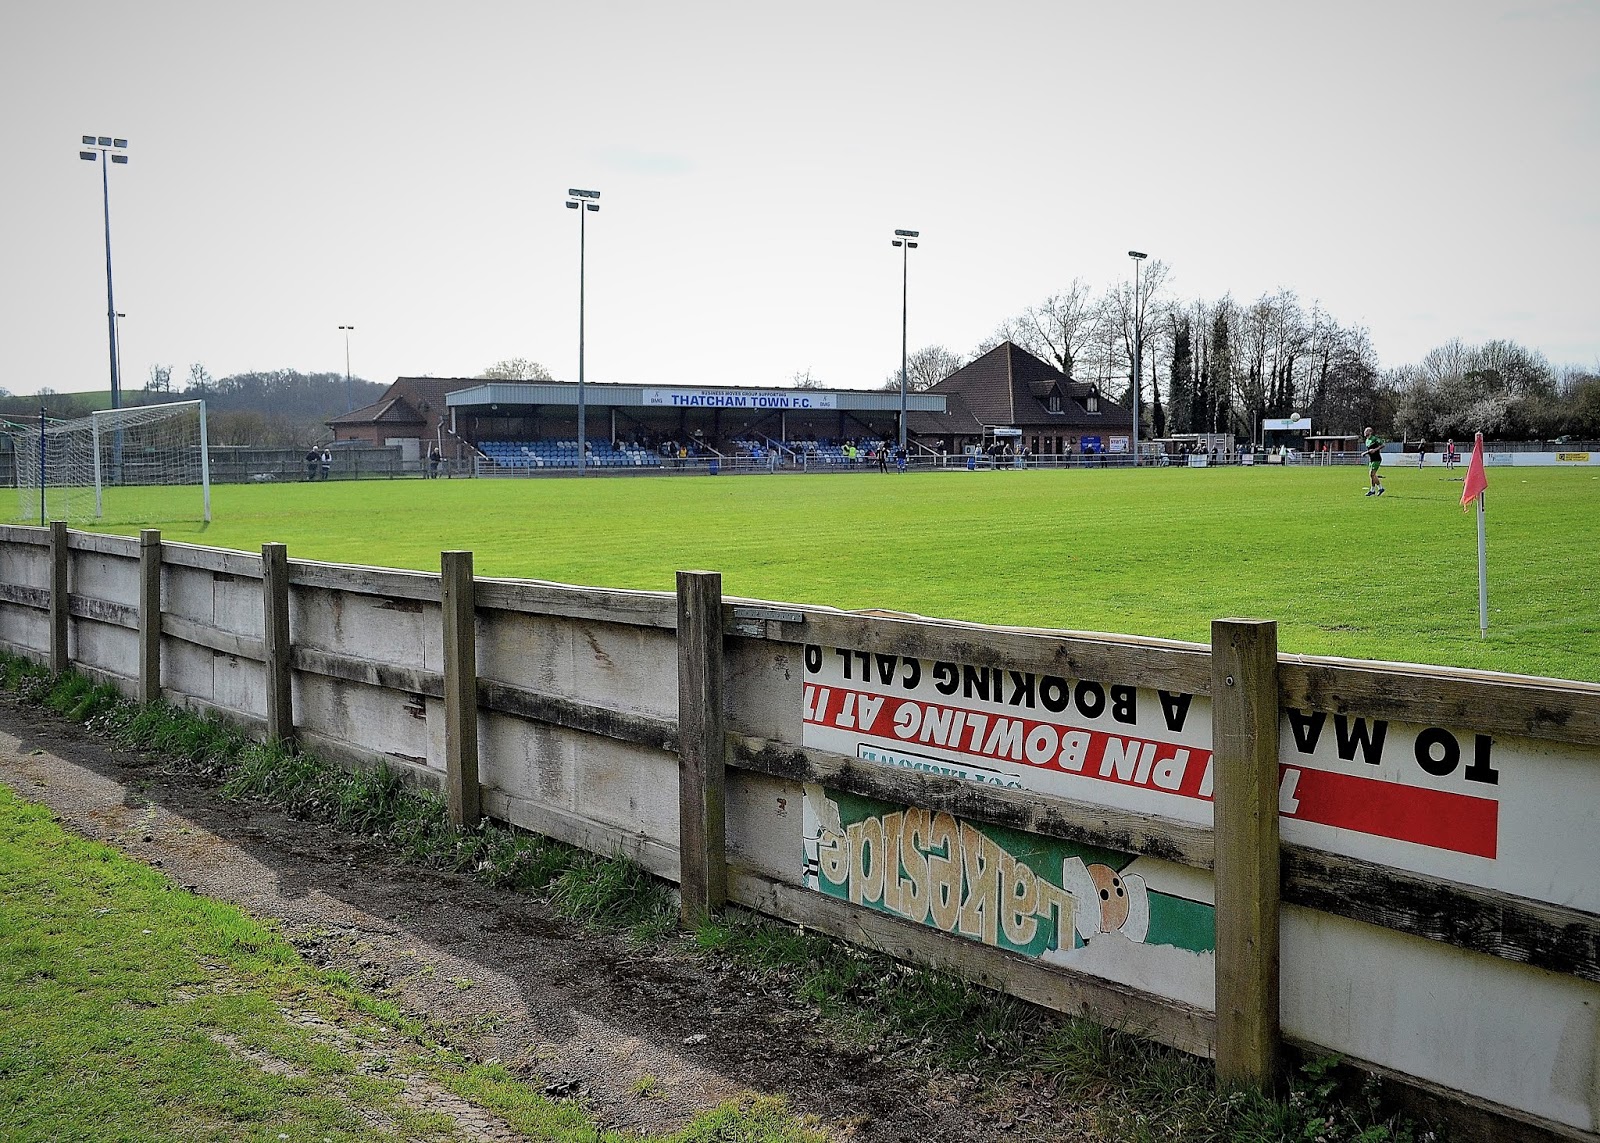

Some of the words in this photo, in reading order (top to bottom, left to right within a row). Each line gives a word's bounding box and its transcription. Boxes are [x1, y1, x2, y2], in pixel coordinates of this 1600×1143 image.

[671, 395, 746, 406] THATCHAM
[751, 397, 789, 407] TOWN
[793, 398, 812, 408] F.C.
[835, 648, 921, 690] CALL
[932, 660, 1137, 726] BOOKING
[835, 692, 884, 731] AT
[1157, 690, 1193, 733] A
[893, 702, 1092, 772] BOWLING
[1414, 727, 1499, 785] TO
[1098, 736, 1190, 791] PIN
